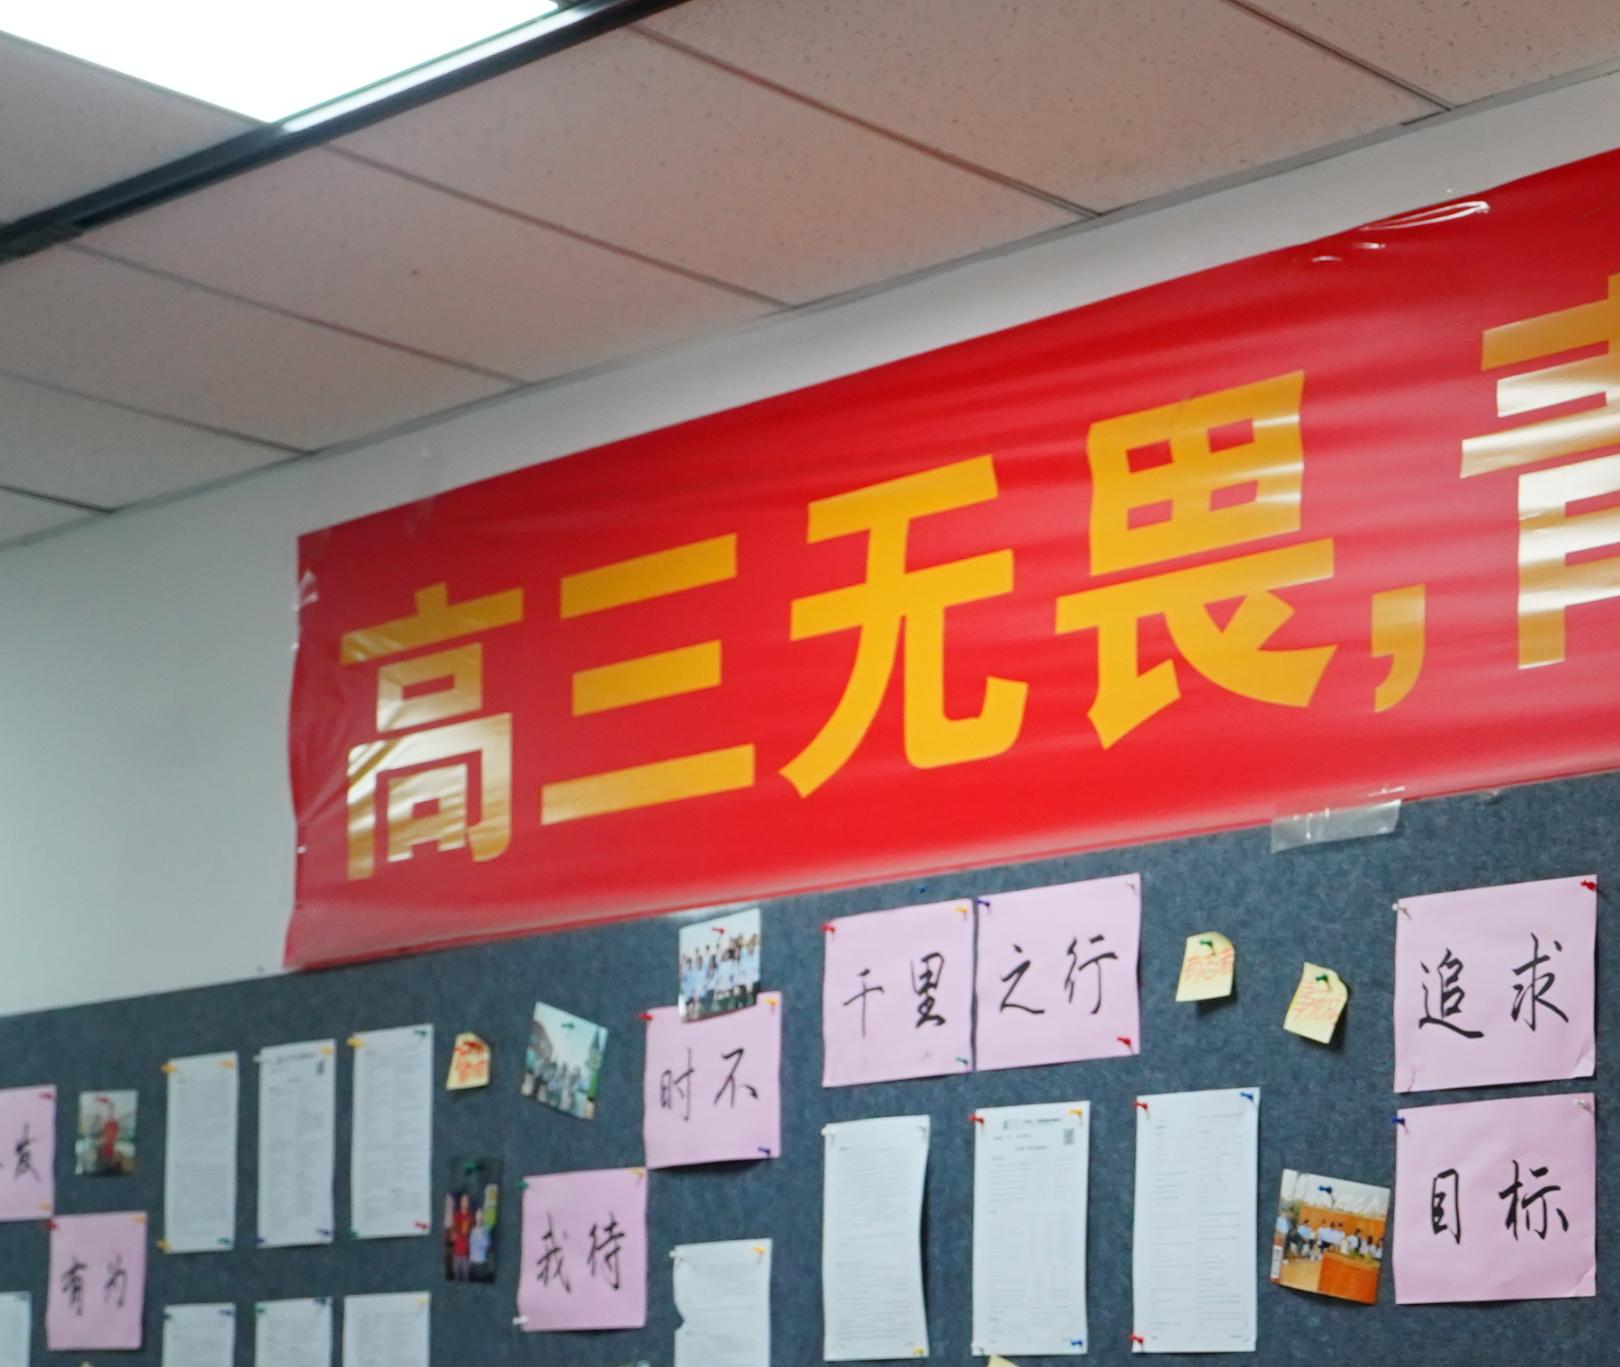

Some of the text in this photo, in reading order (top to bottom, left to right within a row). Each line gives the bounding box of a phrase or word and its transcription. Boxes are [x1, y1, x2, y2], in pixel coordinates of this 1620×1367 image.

[842, 951, 947, 1038] 千里
[999, 934, 1119, 1015] 之行
[1418, 933, 1570, 1040] 追求
[660, 1046, 759, 1124] 时不
[1430, 1159, 1570, 1245] 目标
[61, 1255, 129, 1317] 有为
[536, 1213, 627, 1295] 我待
